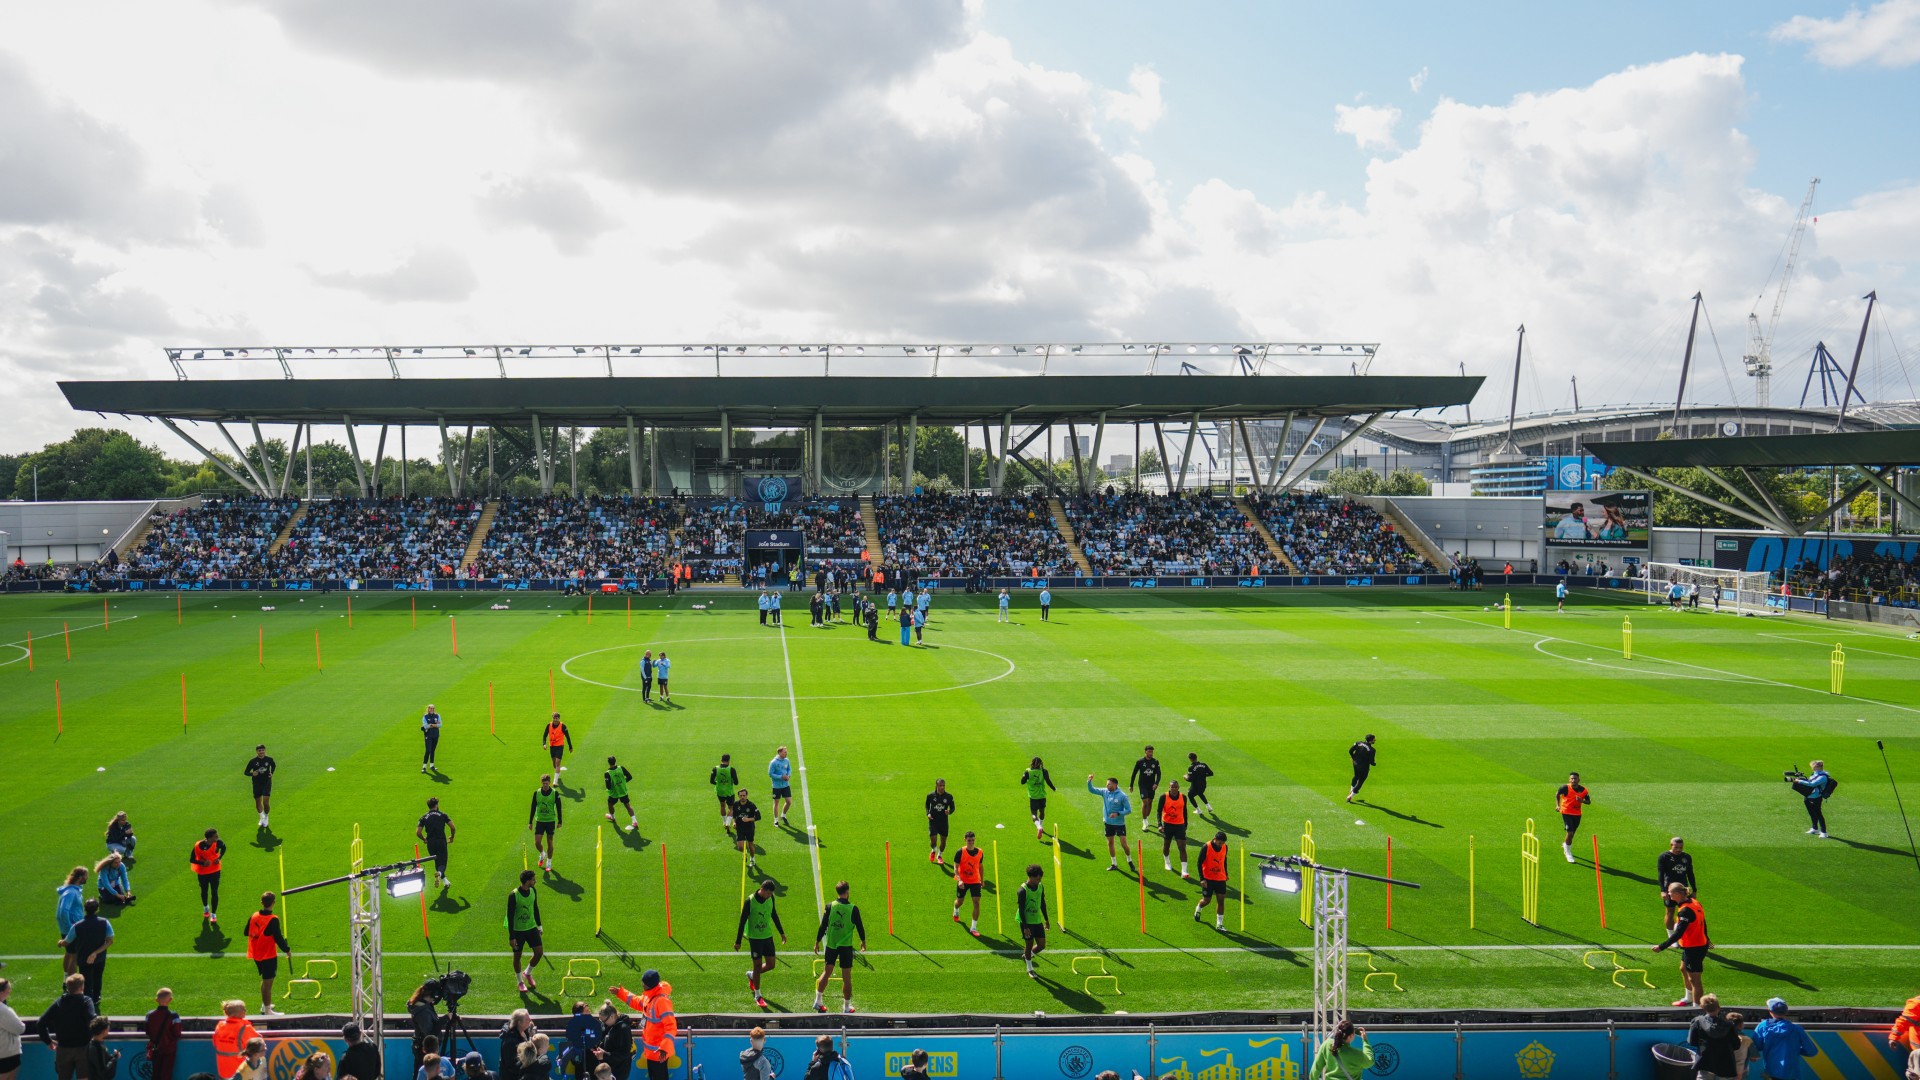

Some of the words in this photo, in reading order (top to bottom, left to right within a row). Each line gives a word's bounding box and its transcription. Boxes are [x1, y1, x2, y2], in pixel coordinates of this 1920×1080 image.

[1191, 578, 1204, 586] CITY
[1406, 576, 1420, 585] CITY
[889, 1056, 954, 1073] CITENS
